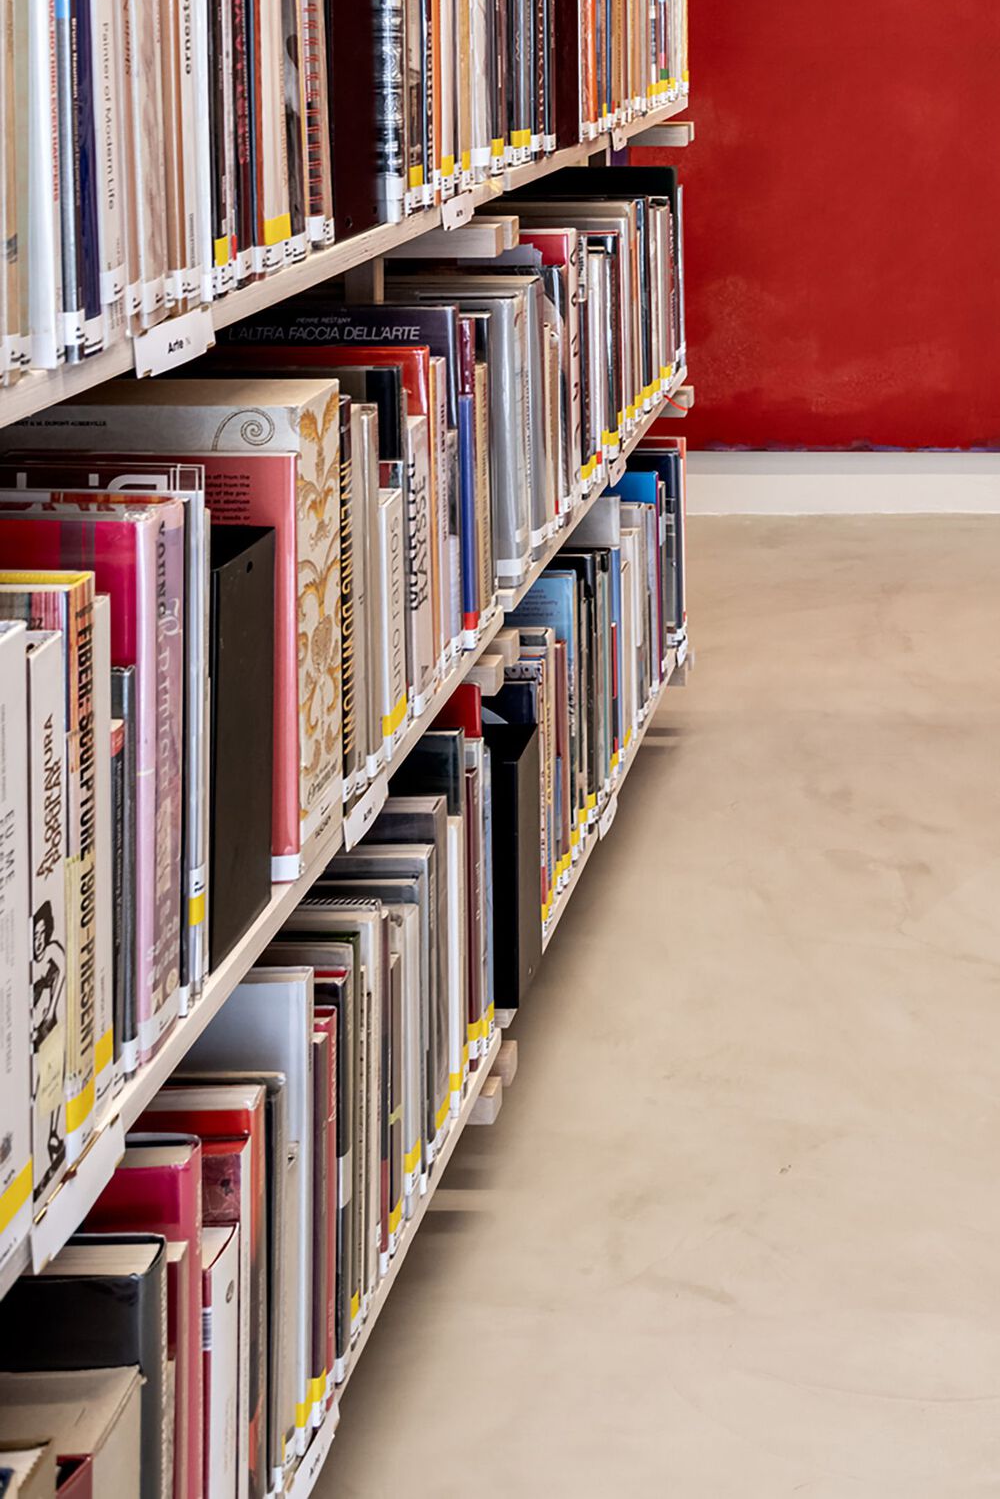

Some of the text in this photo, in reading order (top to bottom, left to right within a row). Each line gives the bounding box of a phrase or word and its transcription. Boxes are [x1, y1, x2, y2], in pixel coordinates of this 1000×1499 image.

[101, 20, 112, 81] Painter
[103, 84, 112, 103] of
[52, 136, 60, 203] HAPPENS
[103, 106, 115, 172] Modern
[106, 179, 116, 210] Life
[167, 338, 184, 354] Arte
[229, 326, 421, 341] L'ALTRA FACCIA DELL'ARTE
[156, 520, 166, 618] YOUNG
[389, 517, 401, 619] ramos
[415, 475, 428, 609] RAYSSE
[340, 458, 356, 755] INVENTING DOWNTOWN
[79, 623, 96, 862] FIBER: SCULPTURE
[50, 757, 62, 865] POPULAR
